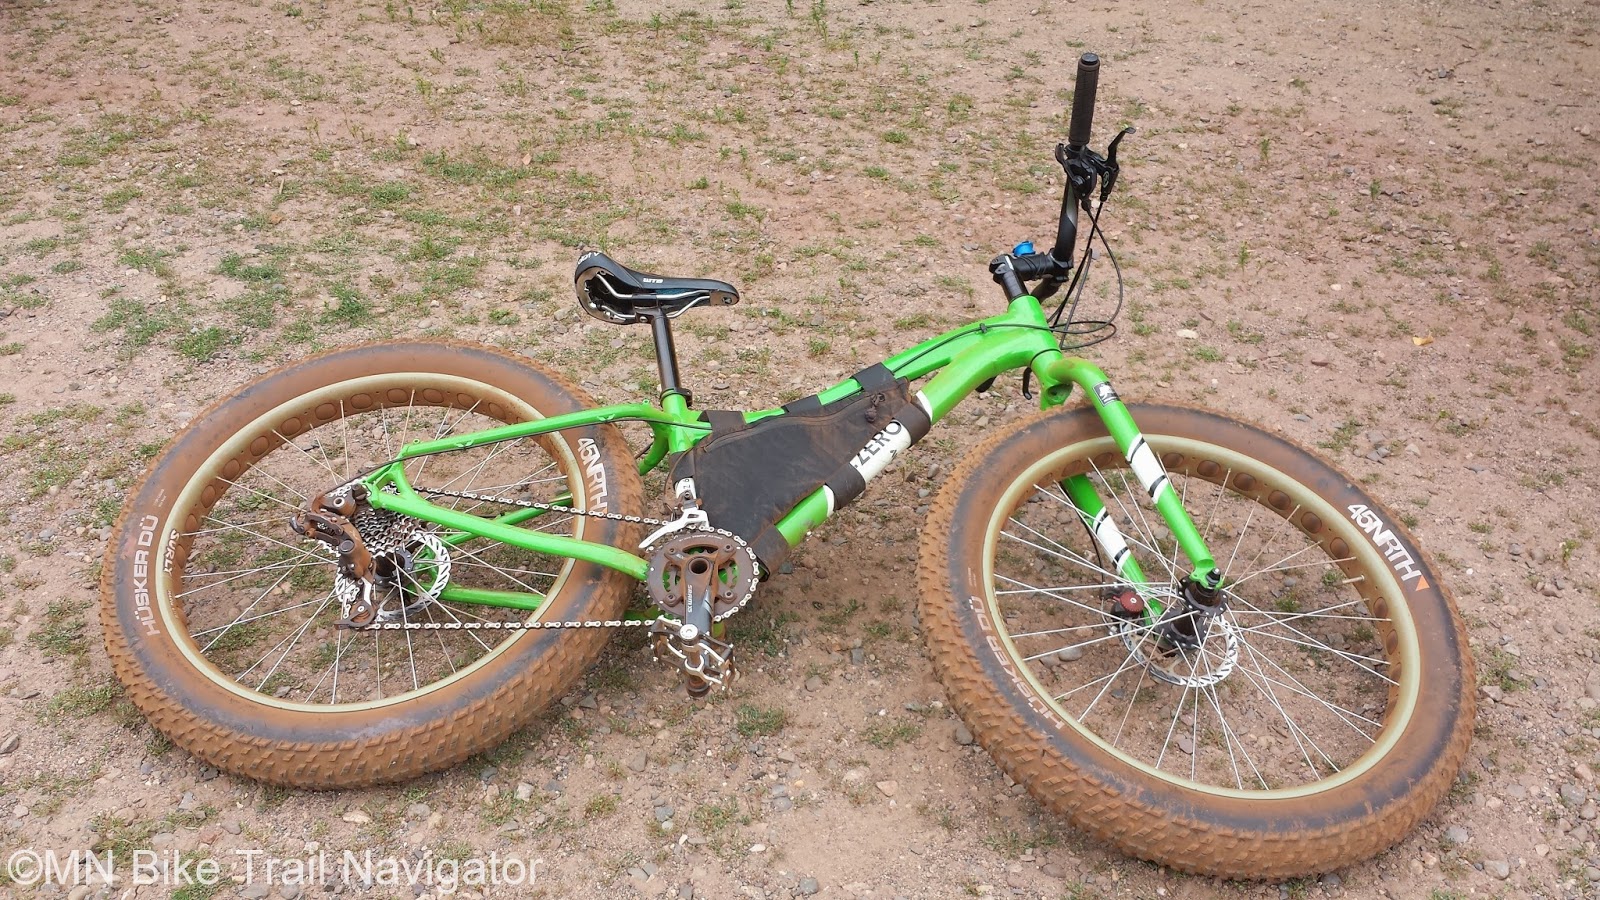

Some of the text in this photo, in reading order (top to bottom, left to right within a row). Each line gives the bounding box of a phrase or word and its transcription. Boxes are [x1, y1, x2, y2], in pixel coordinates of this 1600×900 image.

[133, 514, 161, 636] HÜSKER DÜ
[163, 529, 181, 577] SURLY
[1347, 504, 1422, 581] 45NRTH
[969, 596, 1065, 729] HÜSKER DÜ
